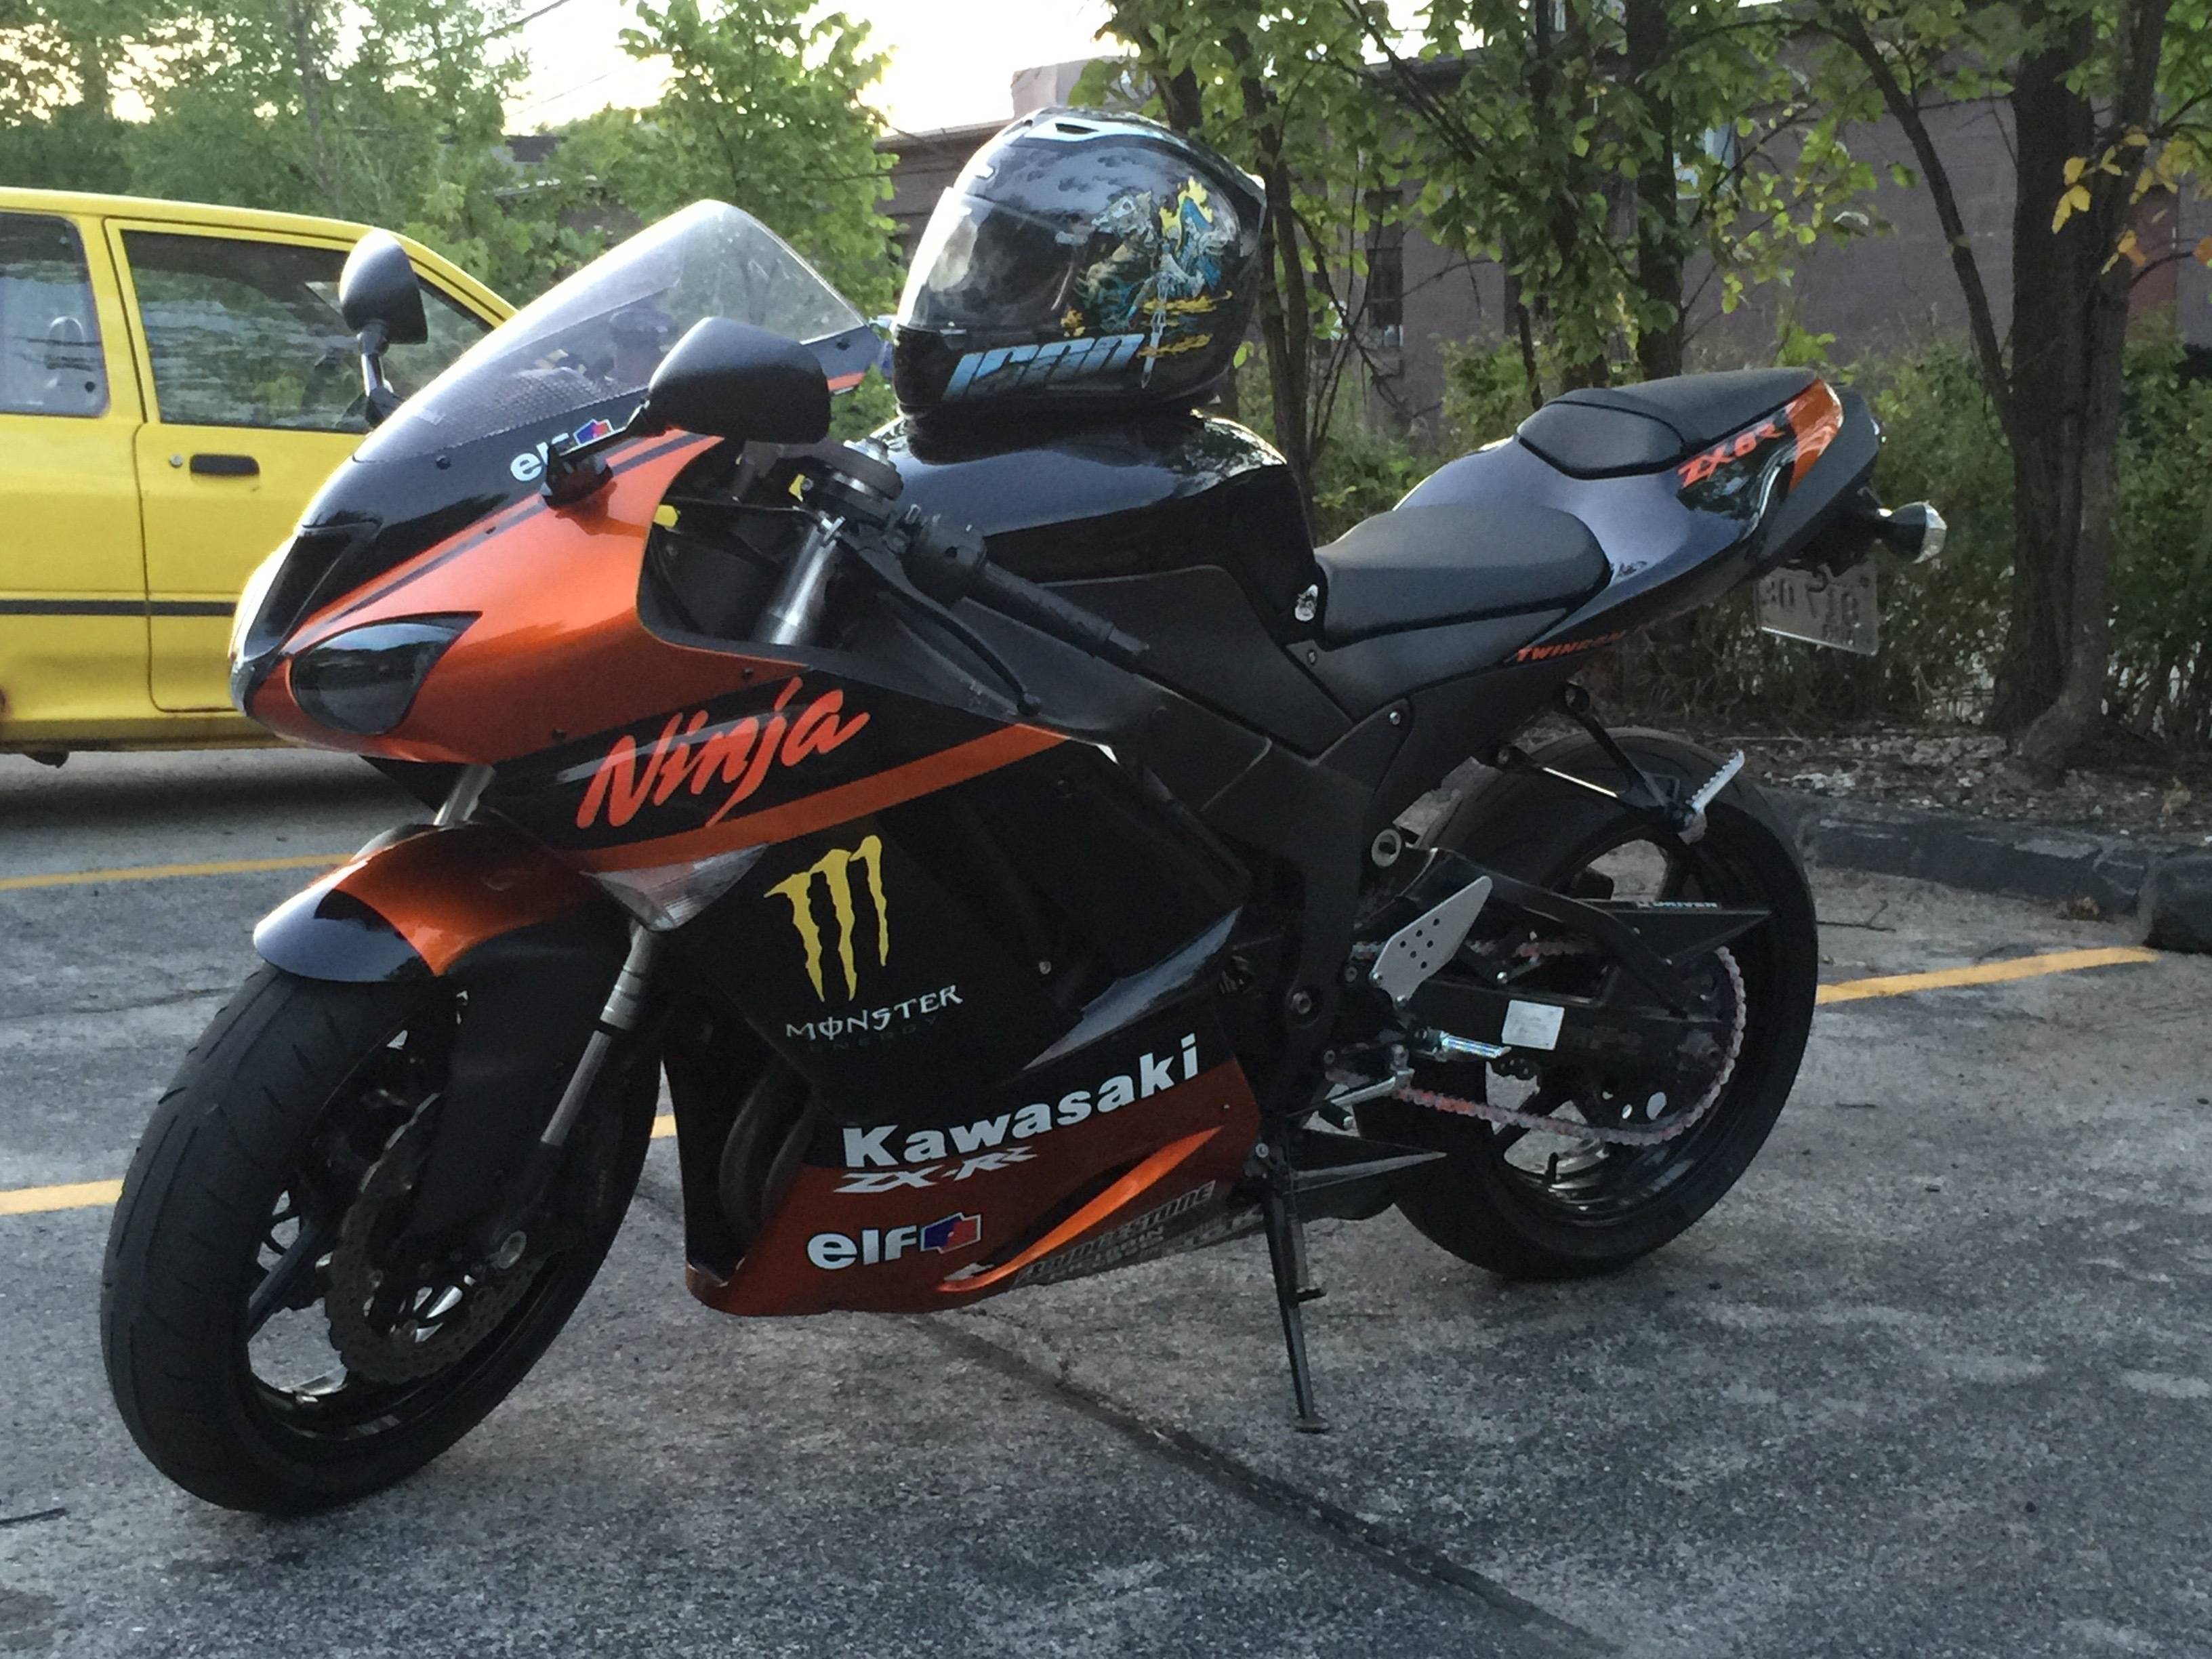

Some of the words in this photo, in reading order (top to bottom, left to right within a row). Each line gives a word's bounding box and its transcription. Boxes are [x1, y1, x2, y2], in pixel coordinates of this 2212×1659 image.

[577, 676, 870, 828] Ninja
[785, 985, 963, 1040] MONSTER
[842, 1033, 1199, 1168] Kawasaki
[806, 1226, 917, 1269] elf
